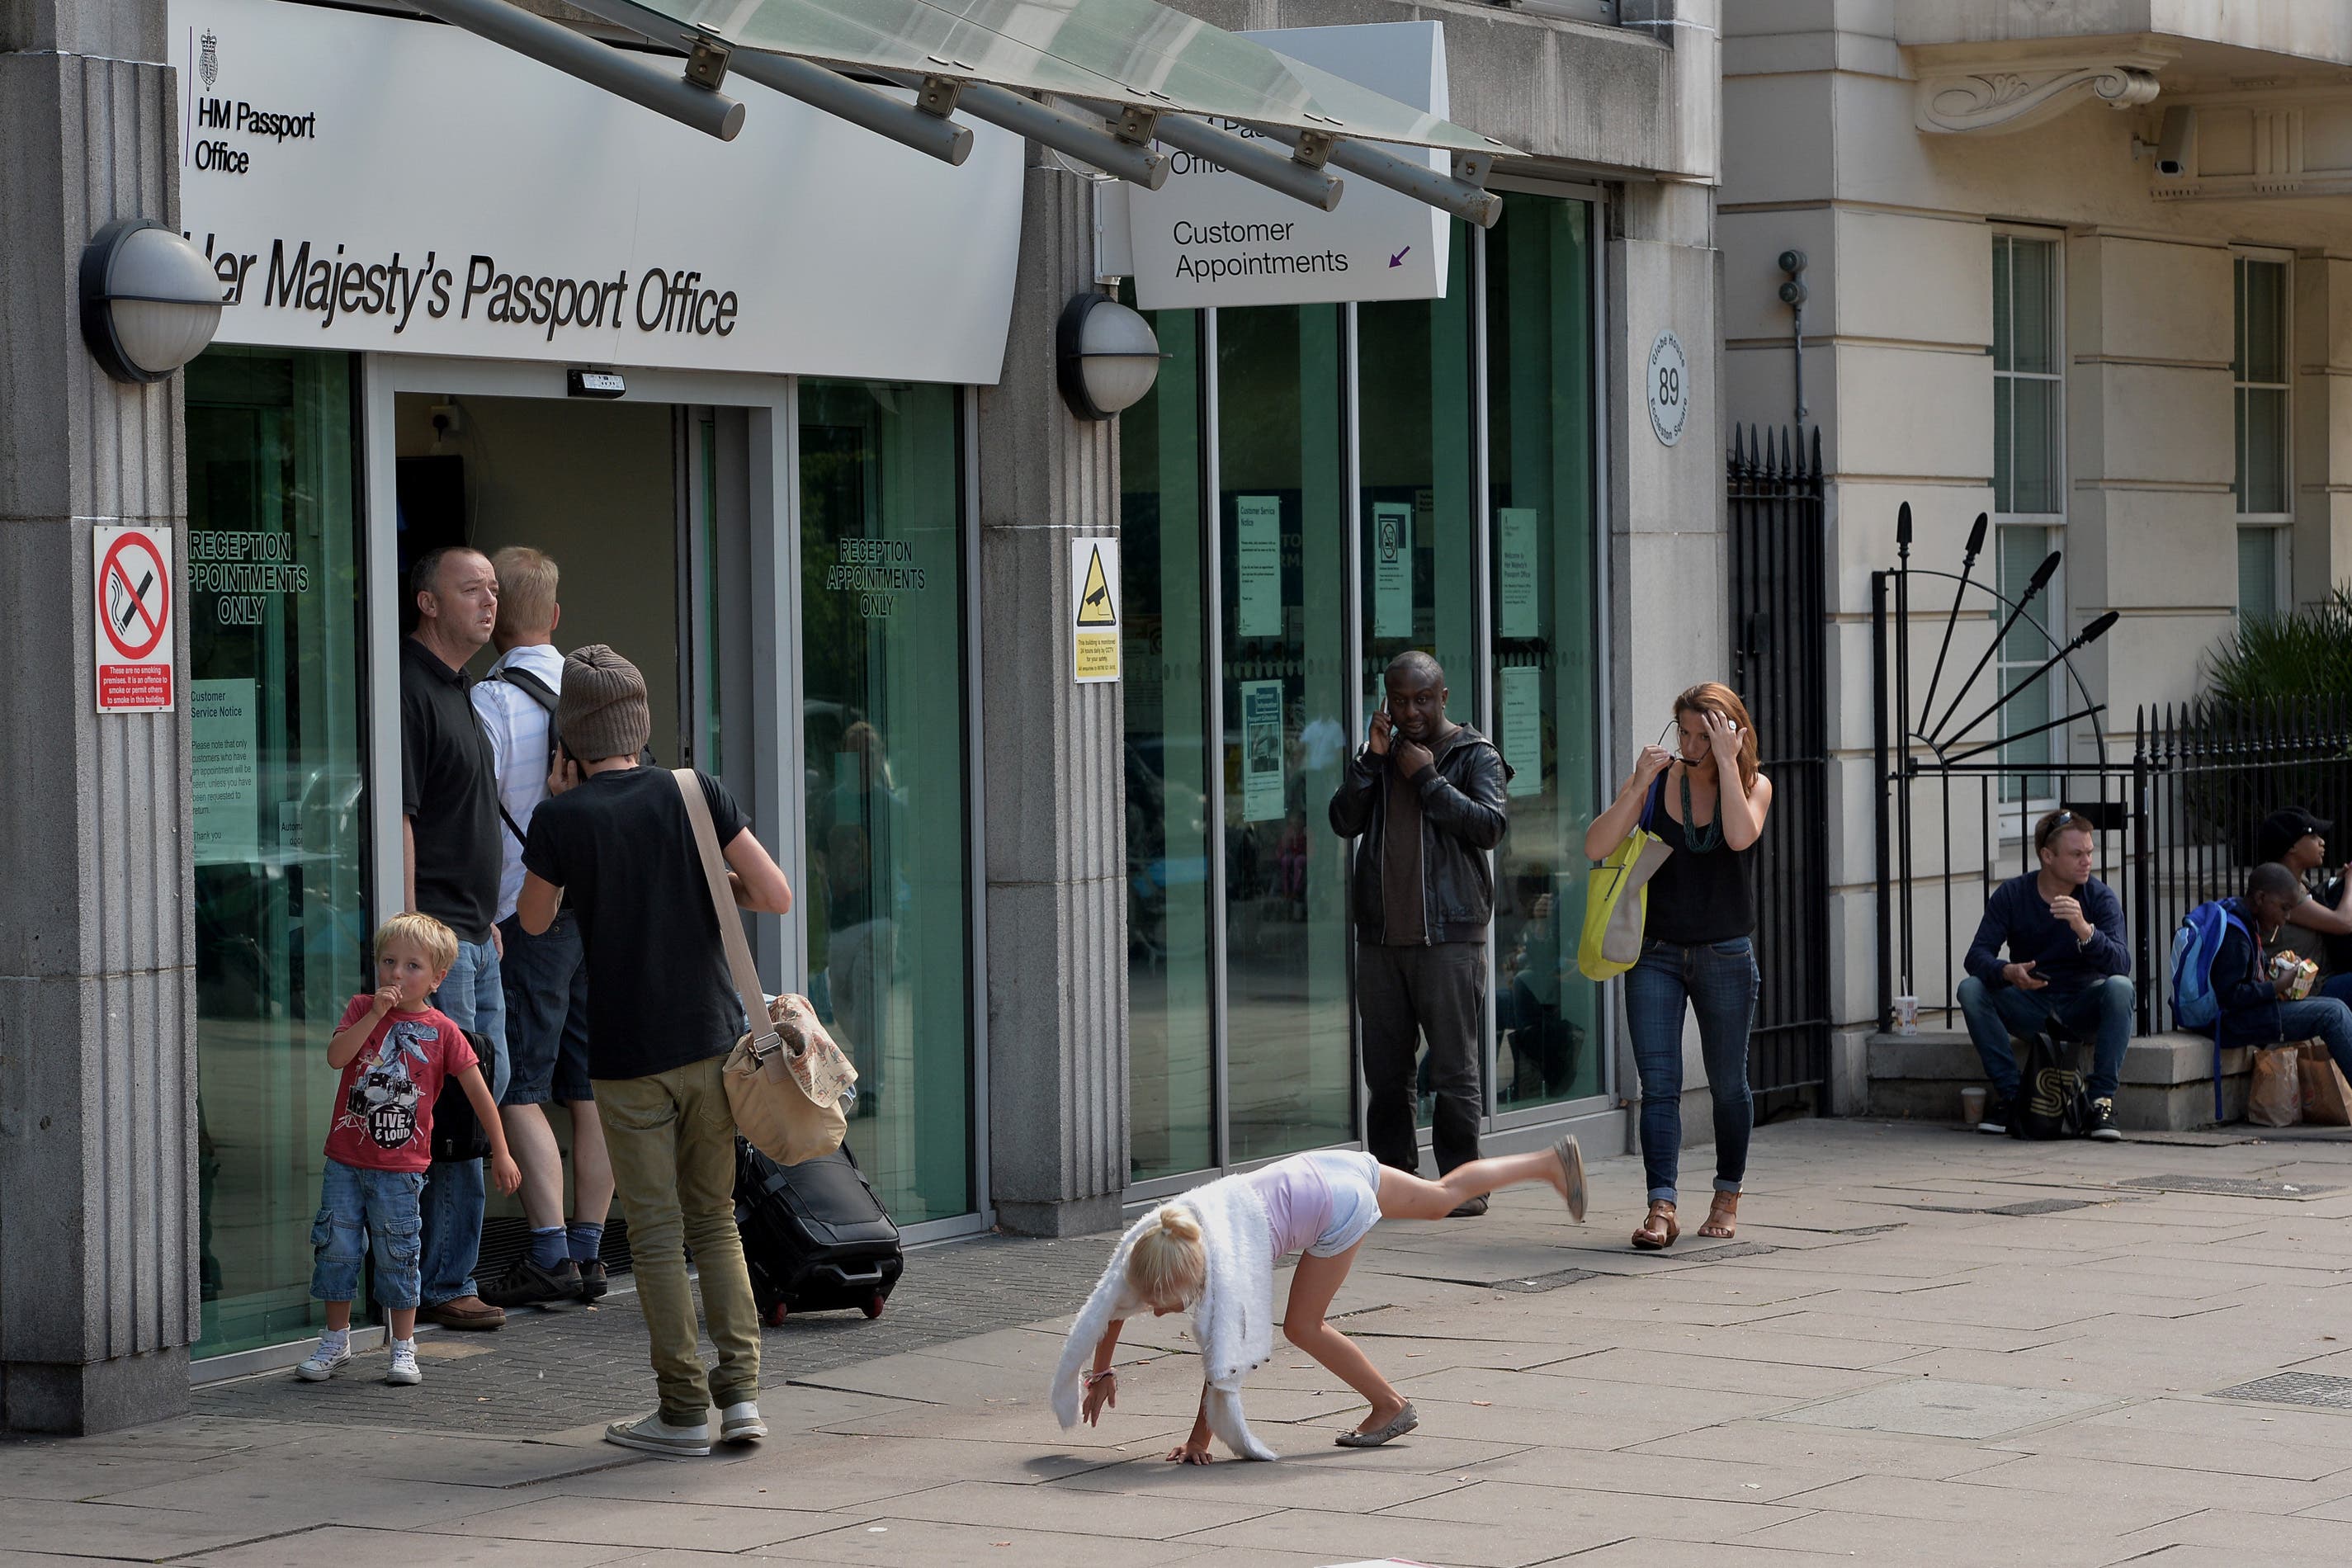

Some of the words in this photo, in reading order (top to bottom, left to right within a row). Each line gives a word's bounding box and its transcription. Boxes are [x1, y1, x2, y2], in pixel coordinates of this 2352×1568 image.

[199, 97, 232, 130] HM
[236, 102, 316, 144] Passport
[195, 140, 249, 174] Office
[1173, 220, 1295, 246] Customer
[1175, 248, 1349, 283] Appointments
[264, 238, 453, 334] Majesty's
[461, 254, 629, 342] Passport
[635, 267, 739, 337] Office
[1651, 336, 1668, 366] Globe
[1669, 333, 1685, 368] House
[1659, 366, 1679, 406] 89
[1651, 397, 1673, 441] Eccleston
[1673, 397, 1688, 437] Square
[190, 531, 290, 560] RECEPTION
[840, 538, 913, 562] RECEPTION
[188, 564, 309, 593] PPOINTMENTS
[826, 564, 925, 591] APPOINTMENTS
[218, 595, 267, 625] ONLY
[860, 593, 895, 618] ONLY
[141, 666, 161, 675] smoking
[191, 691, 225, 701] Customer
[191, 706, 217, 718] Service
[220, 706, 242, 717] Notice
[193, 831, 210, 840] Thank
[375, 1112, 406, 1128] LIVE
[385, 1128, 411, 1141] LOUD
